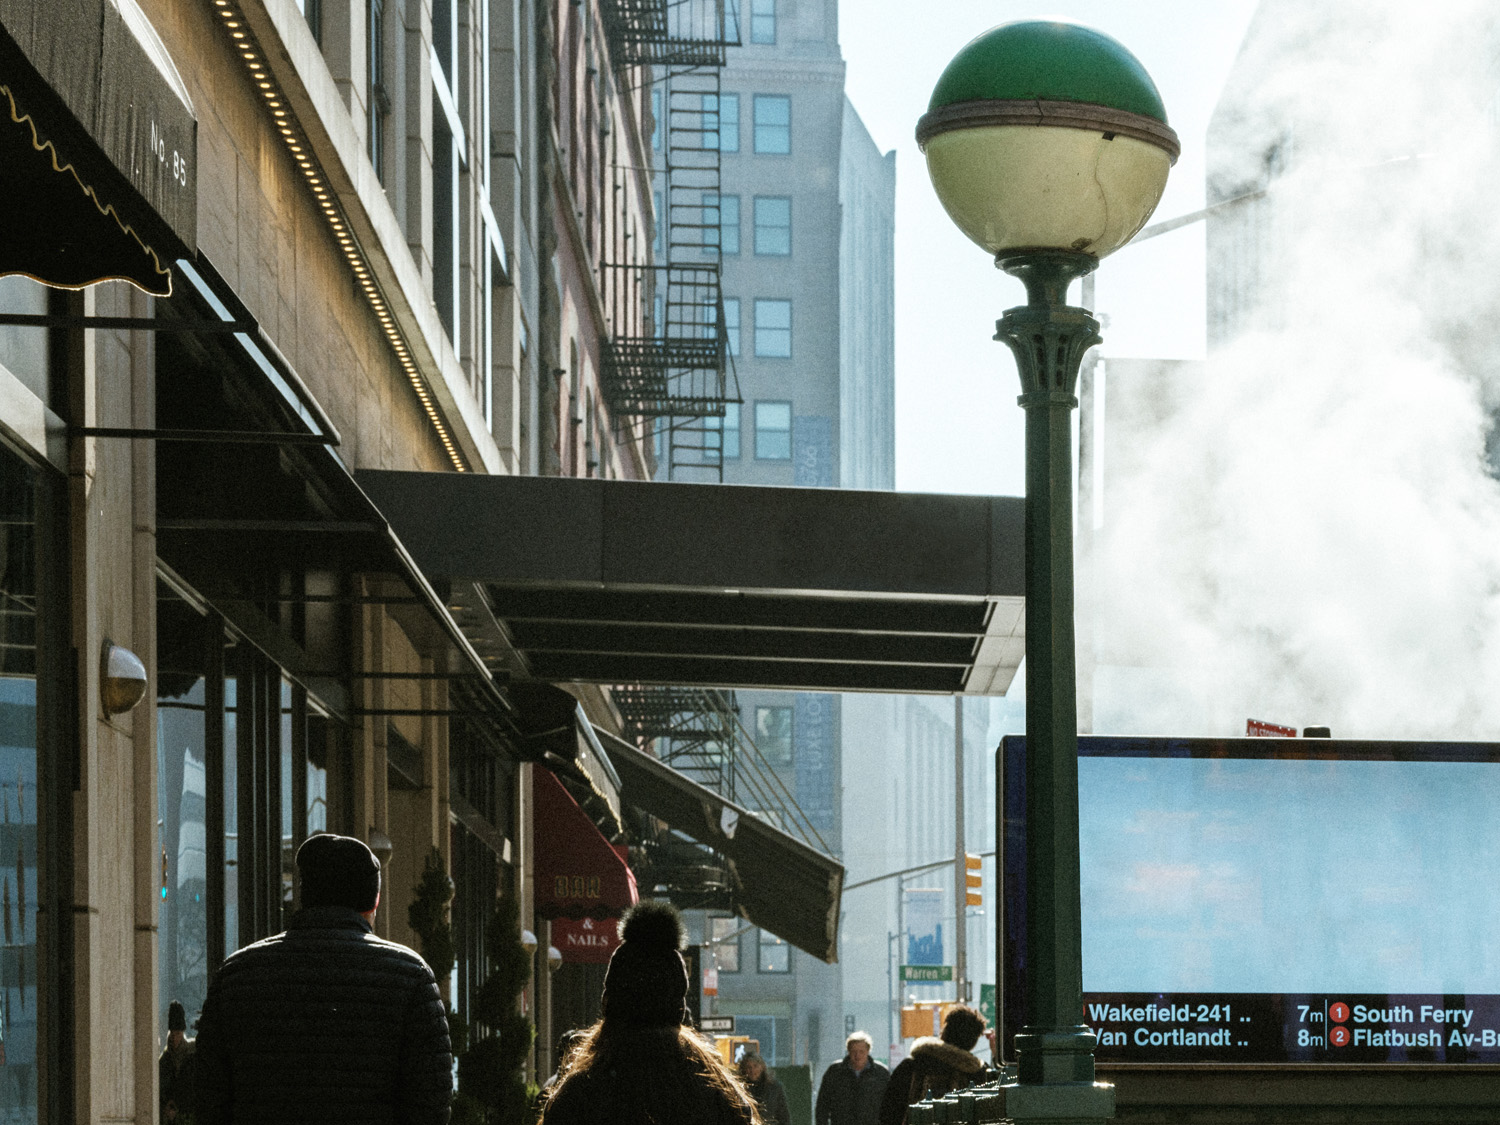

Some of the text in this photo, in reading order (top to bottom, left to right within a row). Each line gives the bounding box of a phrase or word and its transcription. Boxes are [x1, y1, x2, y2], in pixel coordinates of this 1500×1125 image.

[151, 120, 186, 187] No. 85
[1259, 729, 1288, 737] STOPP
[582, 917, 593, 929] &
[567, 933, 609, 946] NAILS
[905, 967, 938, 979] Warren
[1089, 1003, 1231, 1022] Wakefield-241
[1335, 1007, 1342, 1018] 1
[1353, 1005, 1414, 1023] South
[1420, 1005, 1473, 1027] Ferry
[1134, 1028, 1231, 1046] Cortlandt
[1335, 1031, 1344, 1042] 2
[1353, 1029, 1442, 1047] Flatbush
